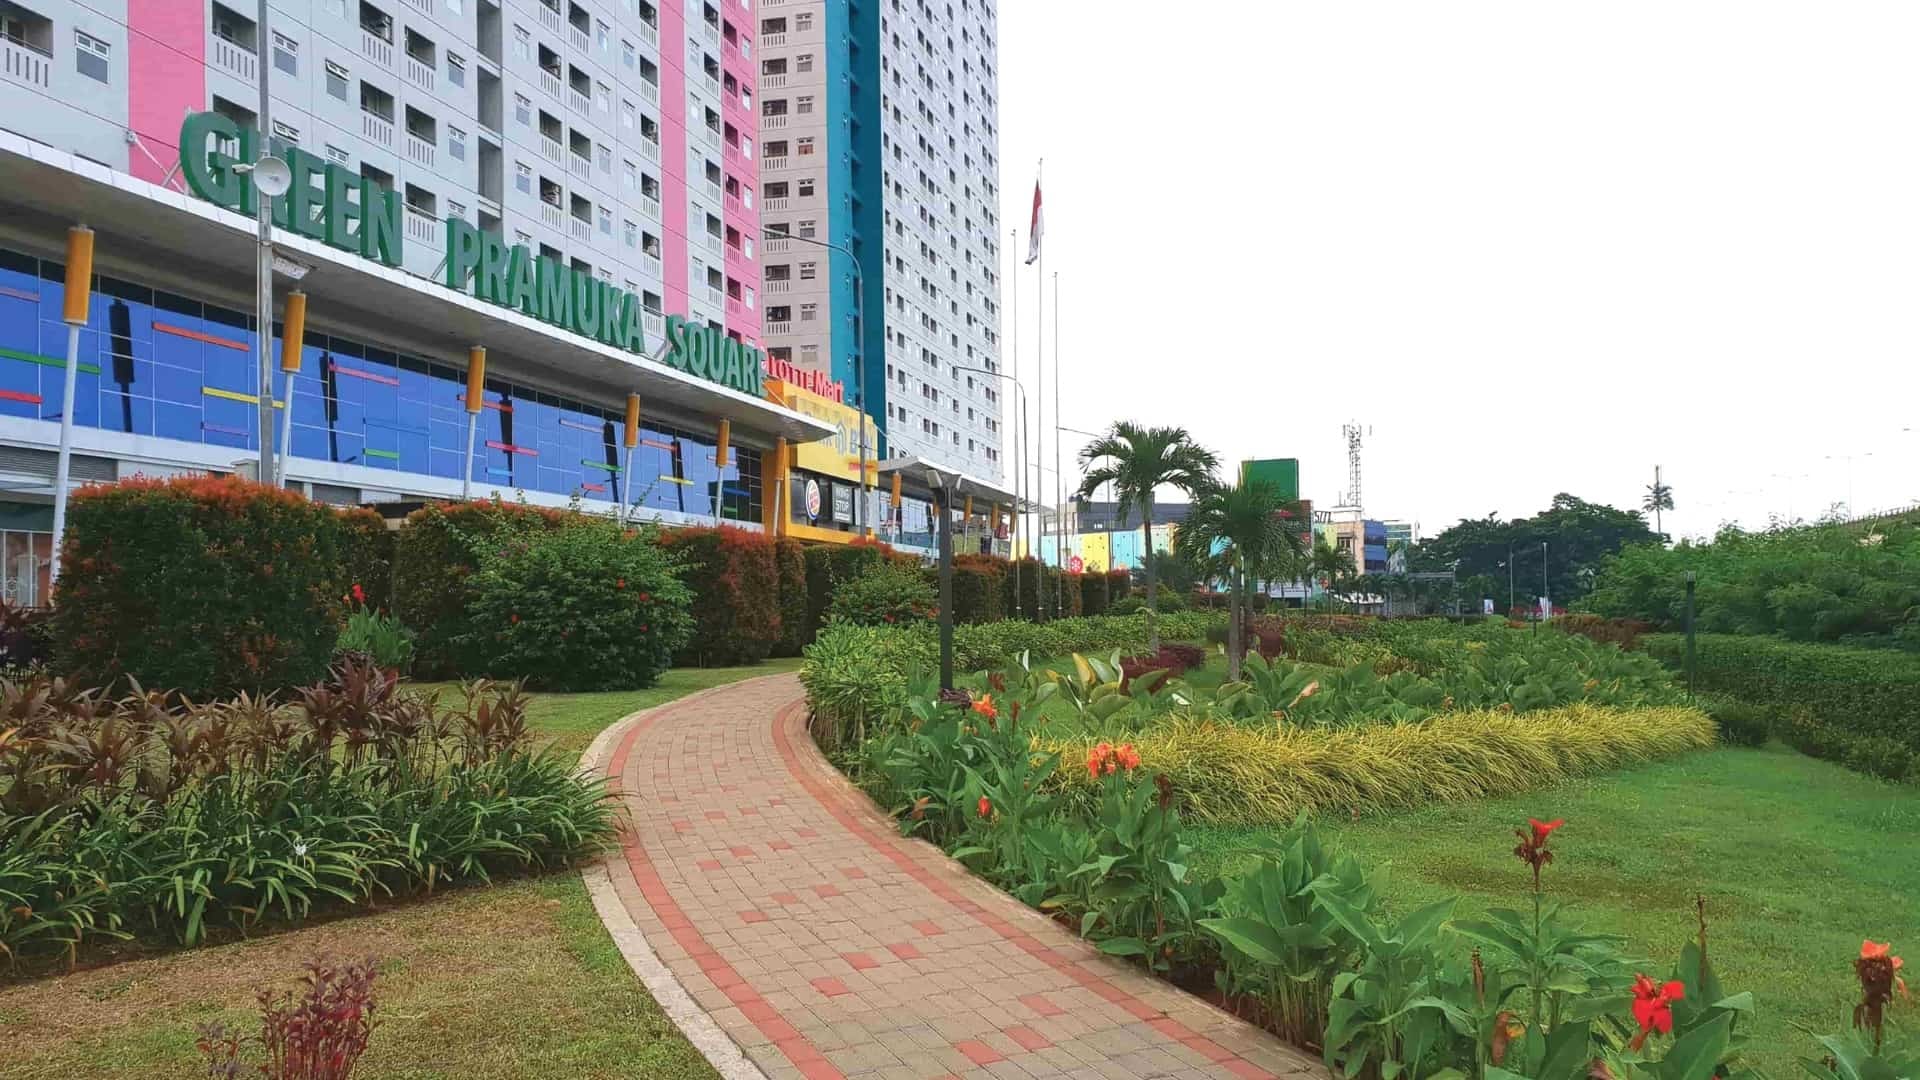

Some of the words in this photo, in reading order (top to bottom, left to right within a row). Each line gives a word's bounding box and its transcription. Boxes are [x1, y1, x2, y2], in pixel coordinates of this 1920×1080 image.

[447, 218, 645, 353] PRAMUKA
[666, 314, 767, 399] SQUARE
[813, 370, 844, 404] Mart
